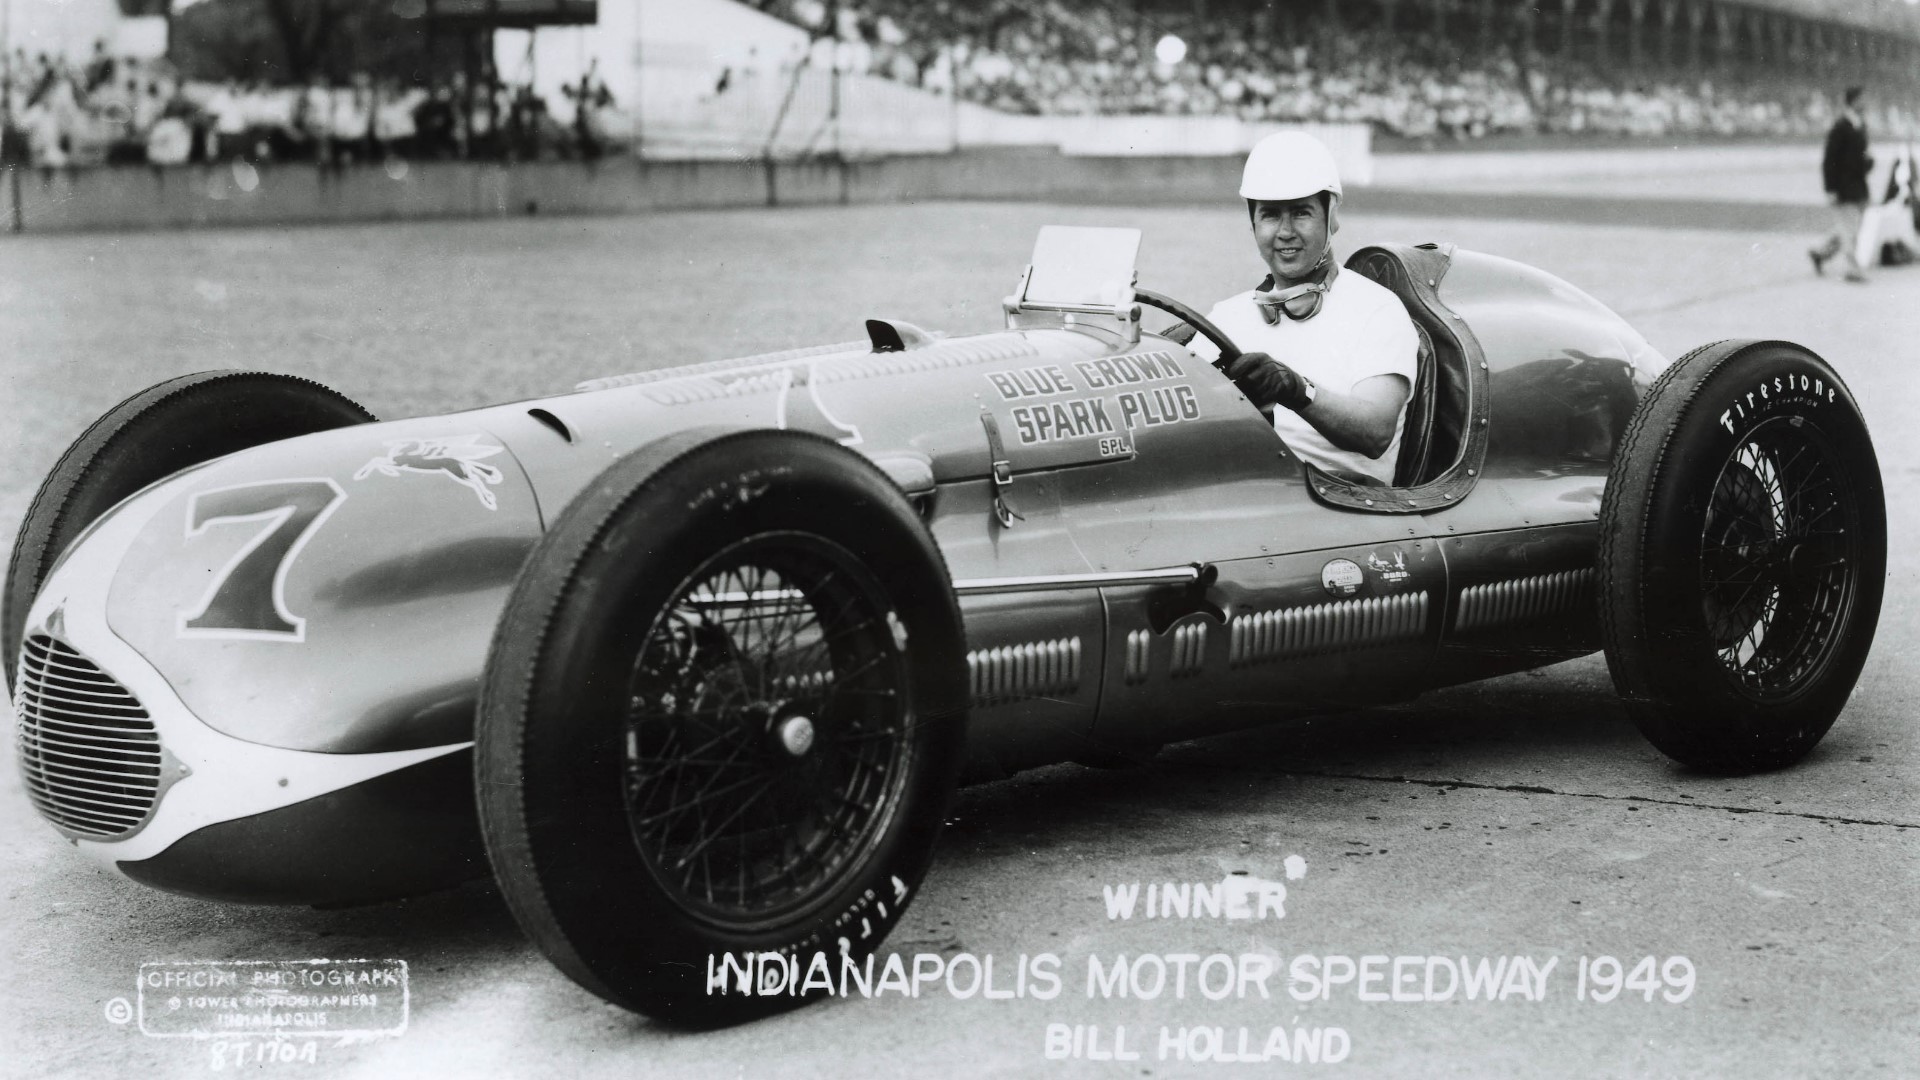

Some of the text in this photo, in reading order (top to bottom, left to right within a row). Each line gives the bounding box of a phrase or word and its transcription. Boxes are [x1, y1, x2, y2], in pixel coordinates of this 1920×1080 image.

[985, 351, 1186, 400] BLUE CROWN
[1719, 372, 1836, 435] Firestone
[1011, 384, 1200, 446] SPARK PLUG
[176, 477, 348, 642] 7
